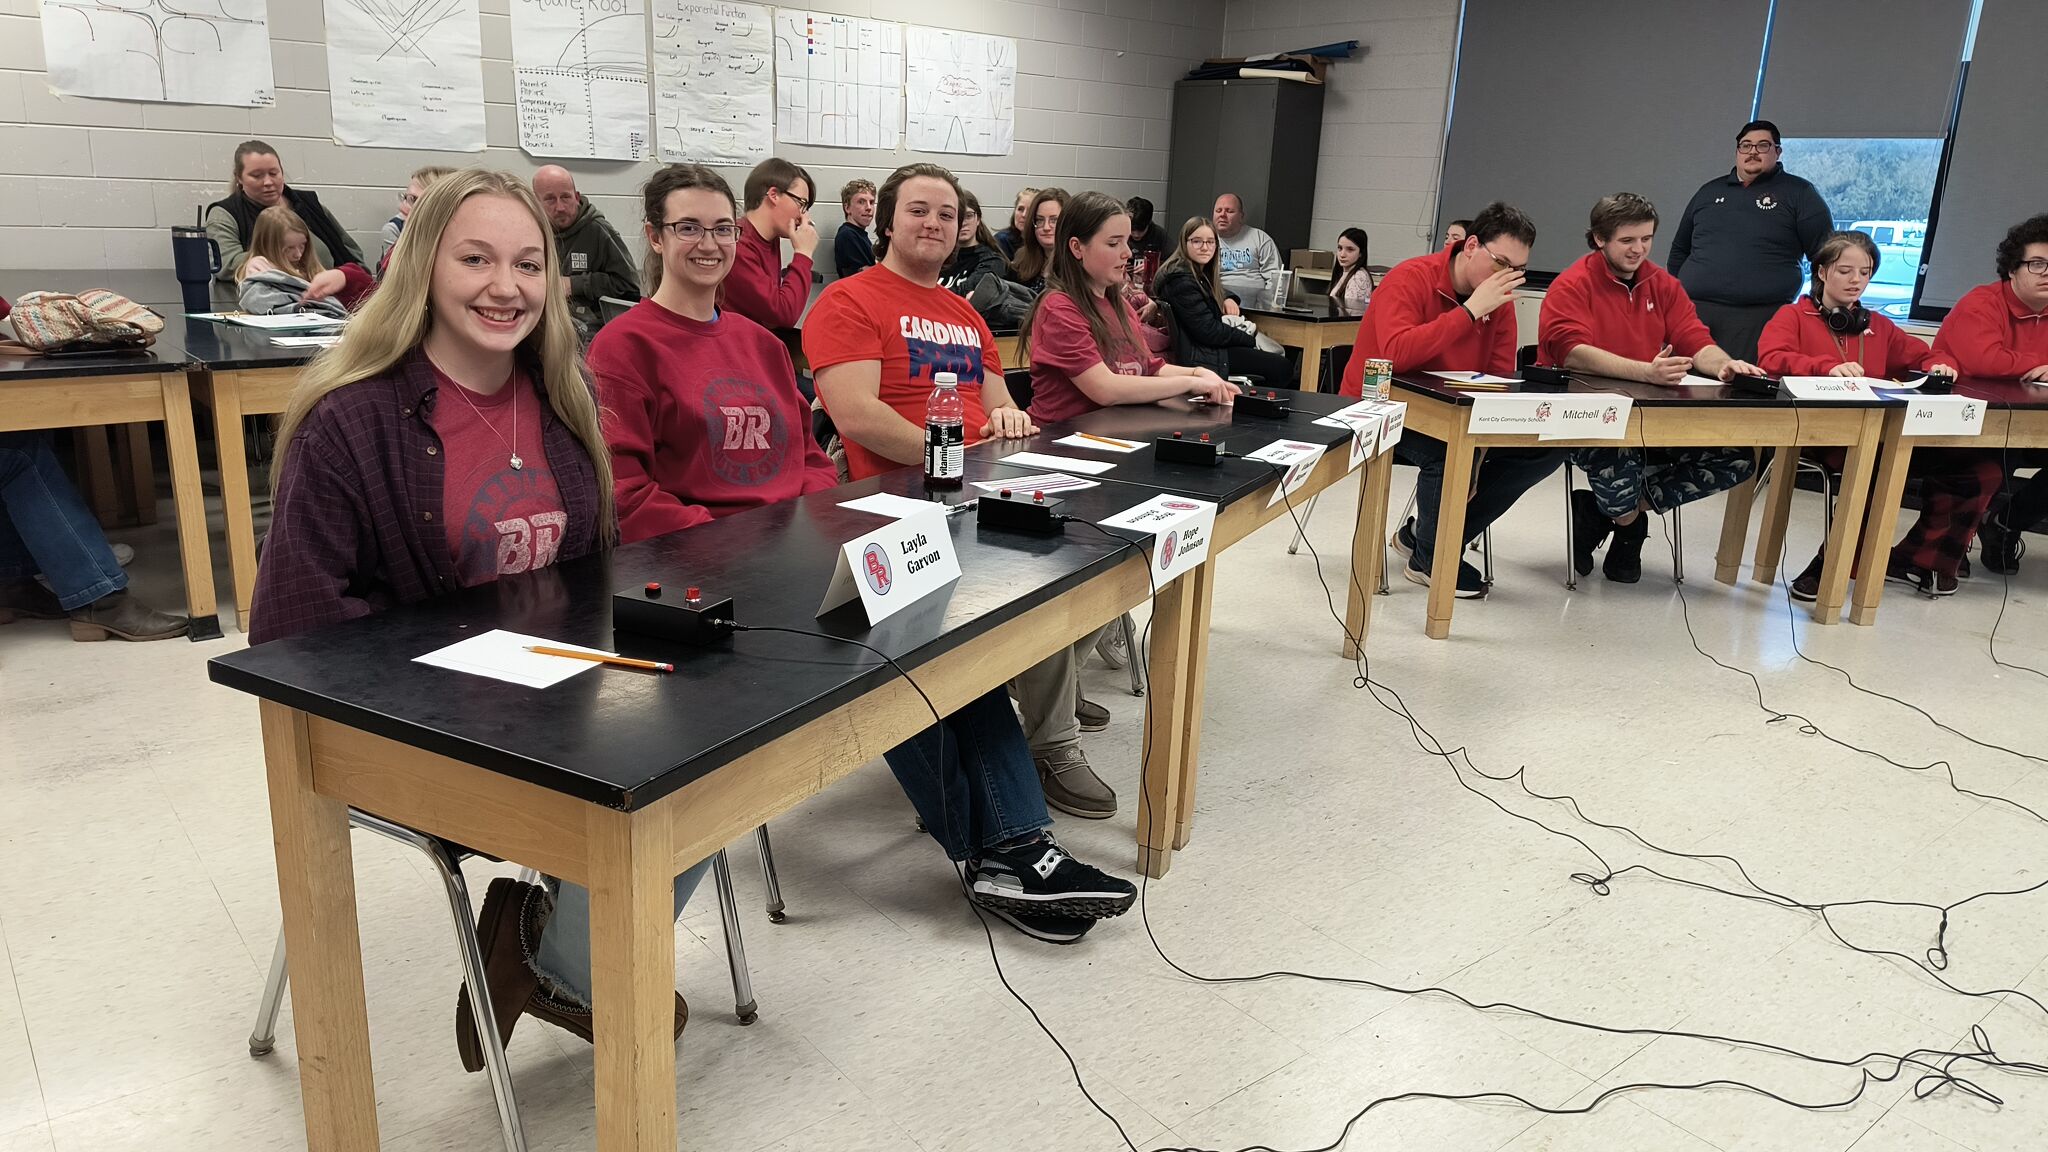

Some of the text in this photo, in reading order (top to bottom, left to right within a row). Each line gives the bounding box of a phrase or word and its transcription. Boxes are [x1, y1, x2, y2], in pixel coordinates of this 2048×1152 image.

[1562, 409, 1600, 419] Mitchell
[1915, 409, 1933, 418] Ava
[719, 405, 772, 450] BR
[494, 510, 568, 575] BR
[900, 532, 928, 555] Layla
[1182, 526, 1199, 541] Hope
[1177, 537, 1205, 557] Johnson
[865, 550, 891, 589] BR
[906, 549, 941, 575] Garvon
